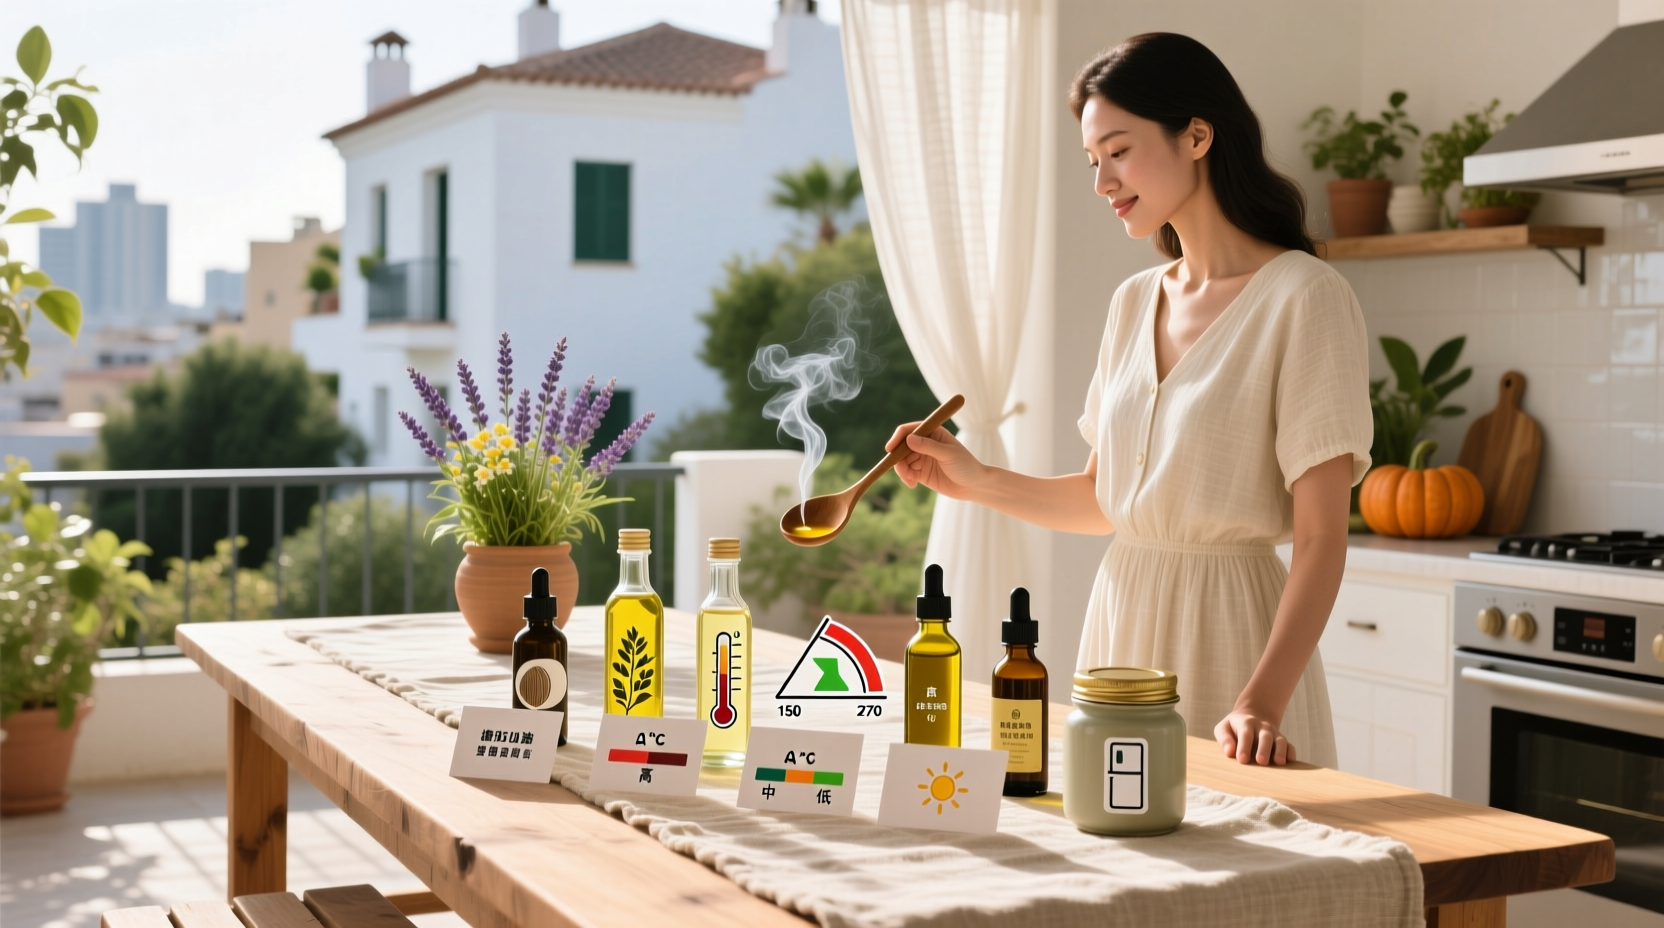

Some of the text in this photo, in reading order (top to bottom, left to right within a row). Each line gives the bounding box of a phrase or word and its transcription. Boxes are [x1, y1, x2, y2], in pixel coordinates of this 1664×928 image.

[778, 705, 801, 717] 150
[856, 705, 882, 717] 270
[761, 784, 832, 806] 中 低
